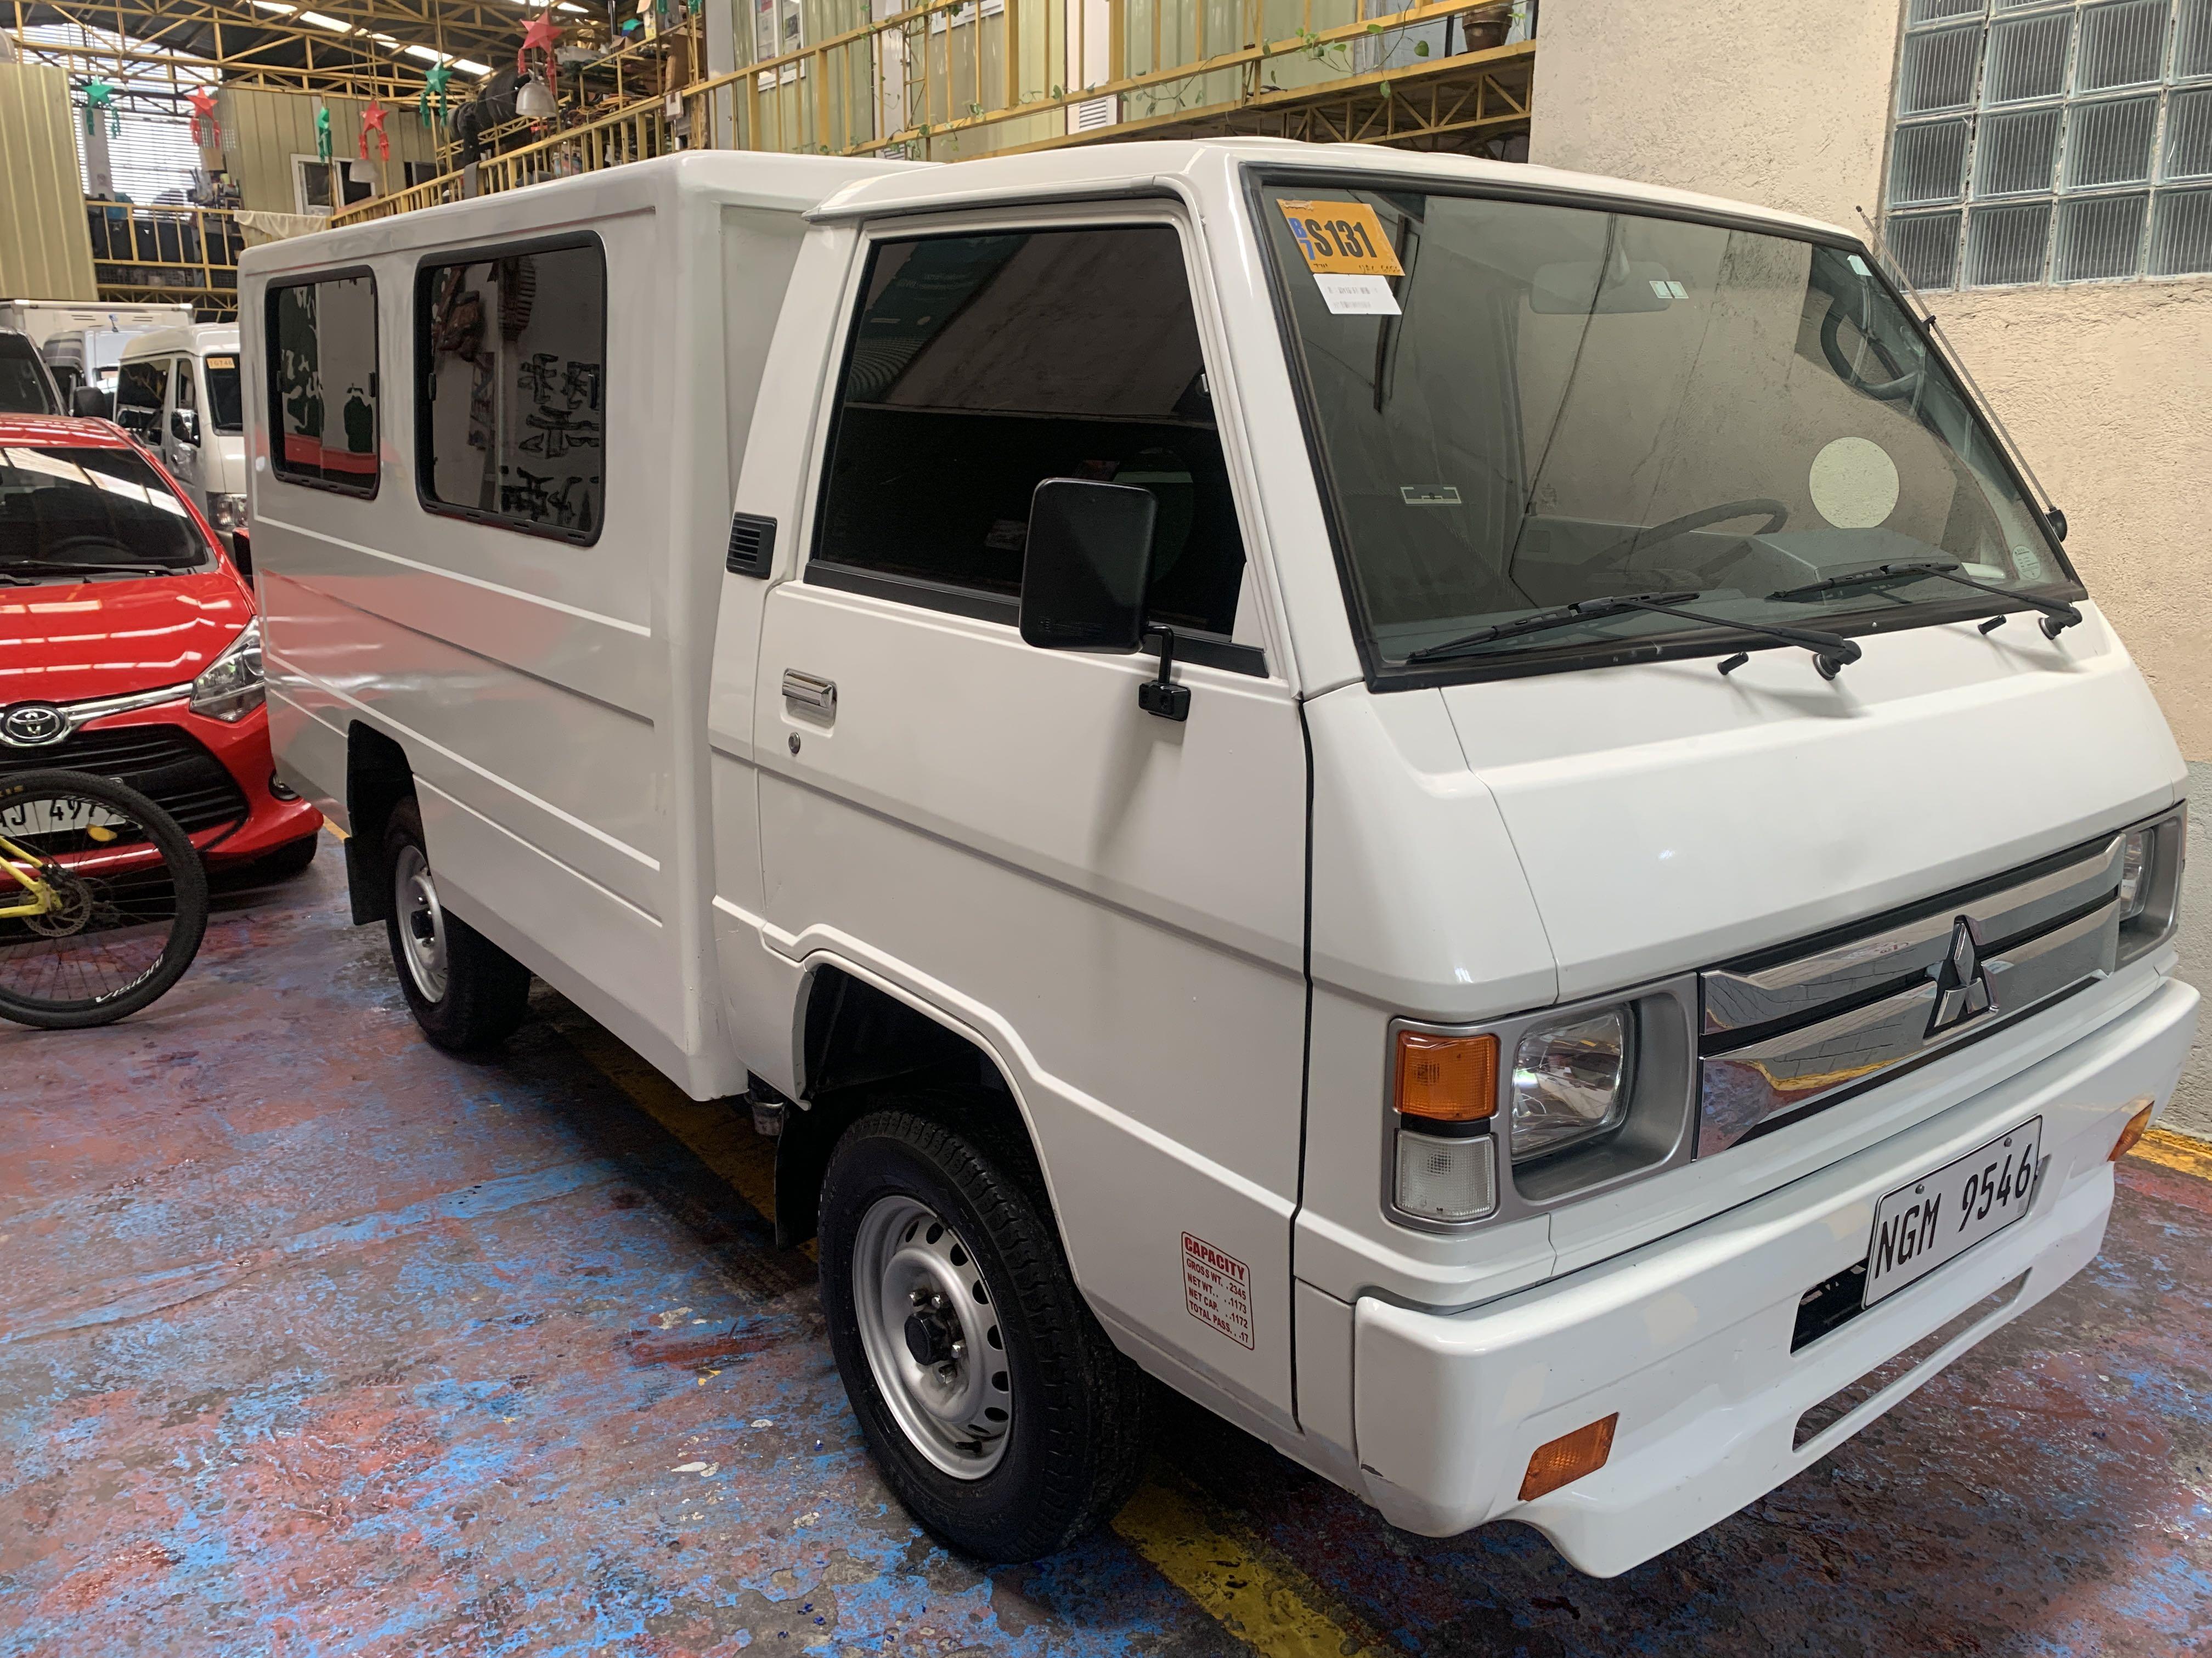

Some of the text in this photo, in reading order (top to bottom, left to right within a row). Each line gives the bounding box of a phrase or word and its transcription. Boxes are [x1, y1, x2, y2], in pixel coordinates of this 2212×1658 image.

[1305, 219, 1377, 258] S131
[1875, 1143, 2032, 1279] NGM 9546
[1184, 1236, 1244, 1281] CAPACITY
[1187, 1258, 1210, 1278] GROSS
[1187, 1272, 1201, 1288] NET
[1188, 1286, 1202, 1301] NET
[1189, 1300, 1211, 1321] TOTAL
